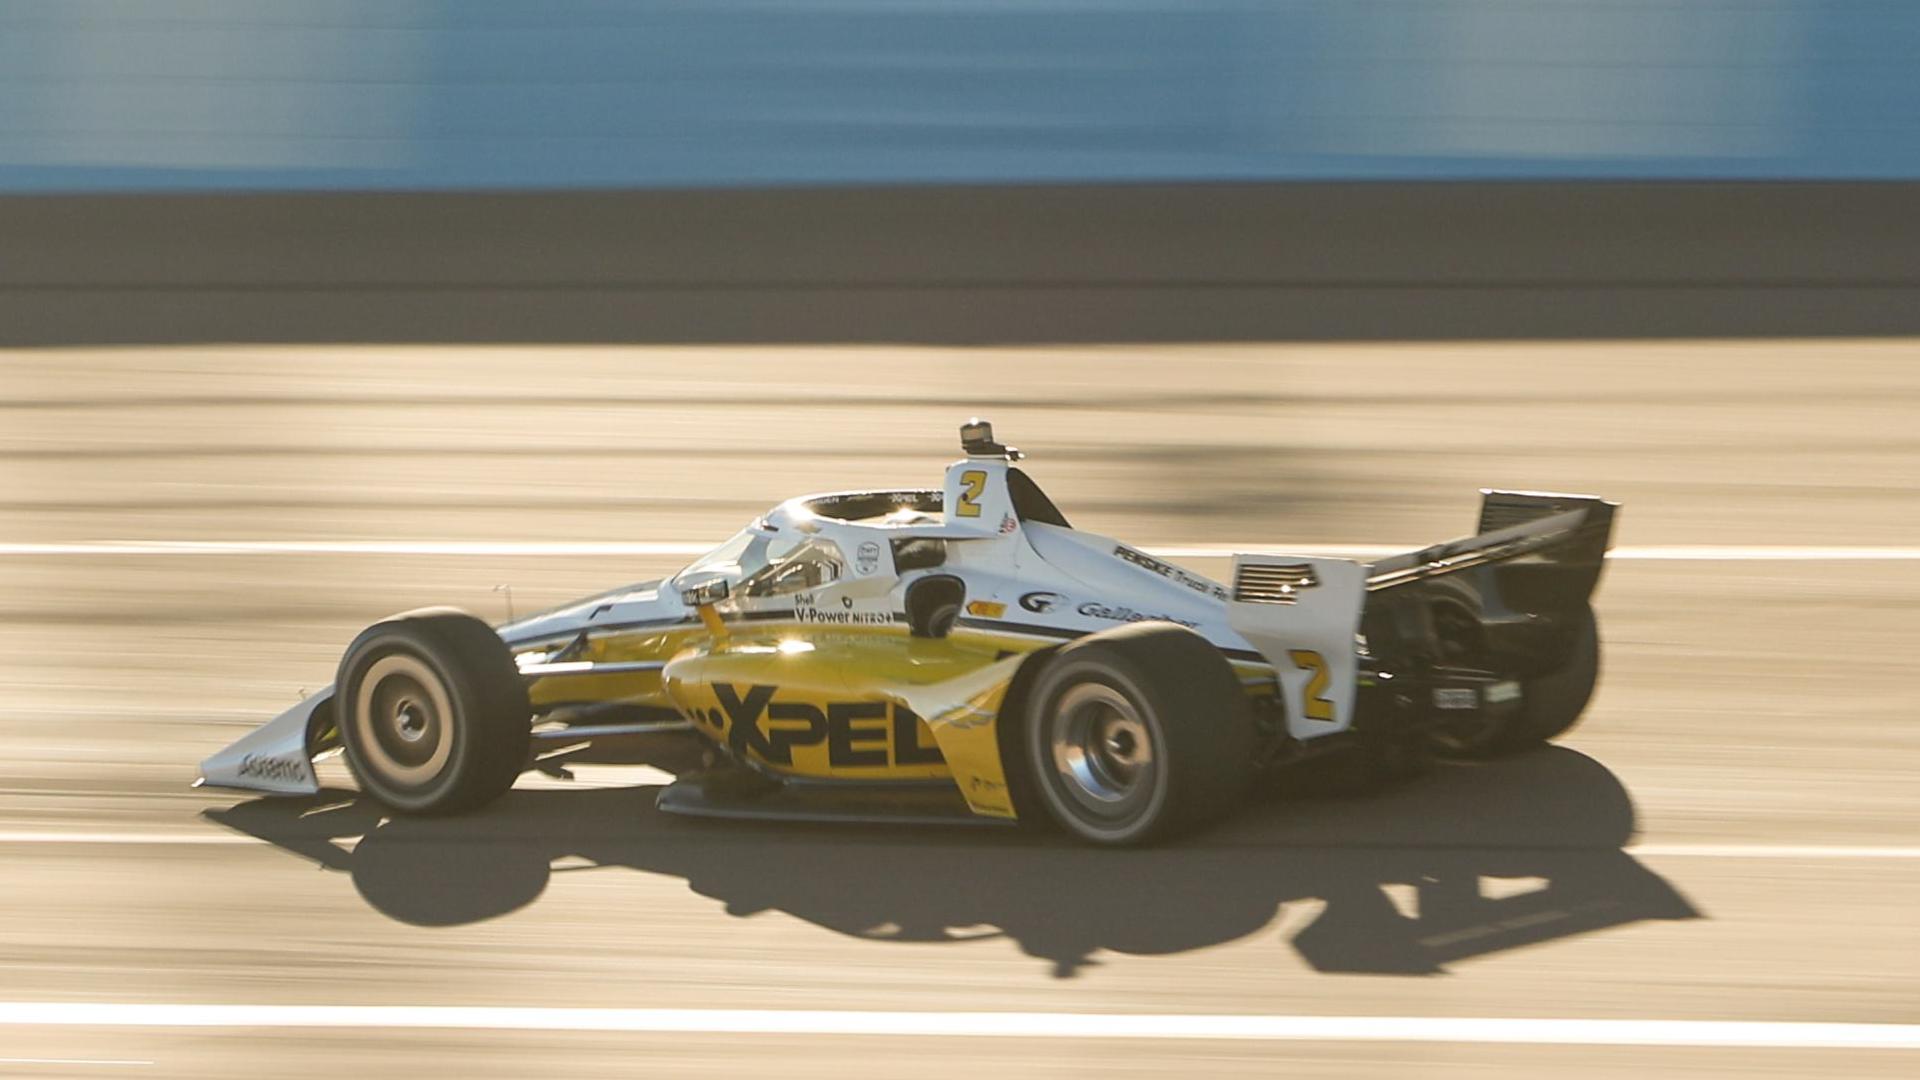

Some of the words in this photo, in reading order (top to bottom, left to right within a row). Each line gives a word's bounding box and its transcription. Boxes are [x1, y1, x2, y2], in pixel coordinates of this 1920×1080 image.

[955, 470, 987, 517] 2
[1114, 546, 1172, 577] PENSKE
[796, 608, 850, 623] V-Power
[1286, 649, 1337, 722] 2
[711, 682, 949, 768] XPEL
